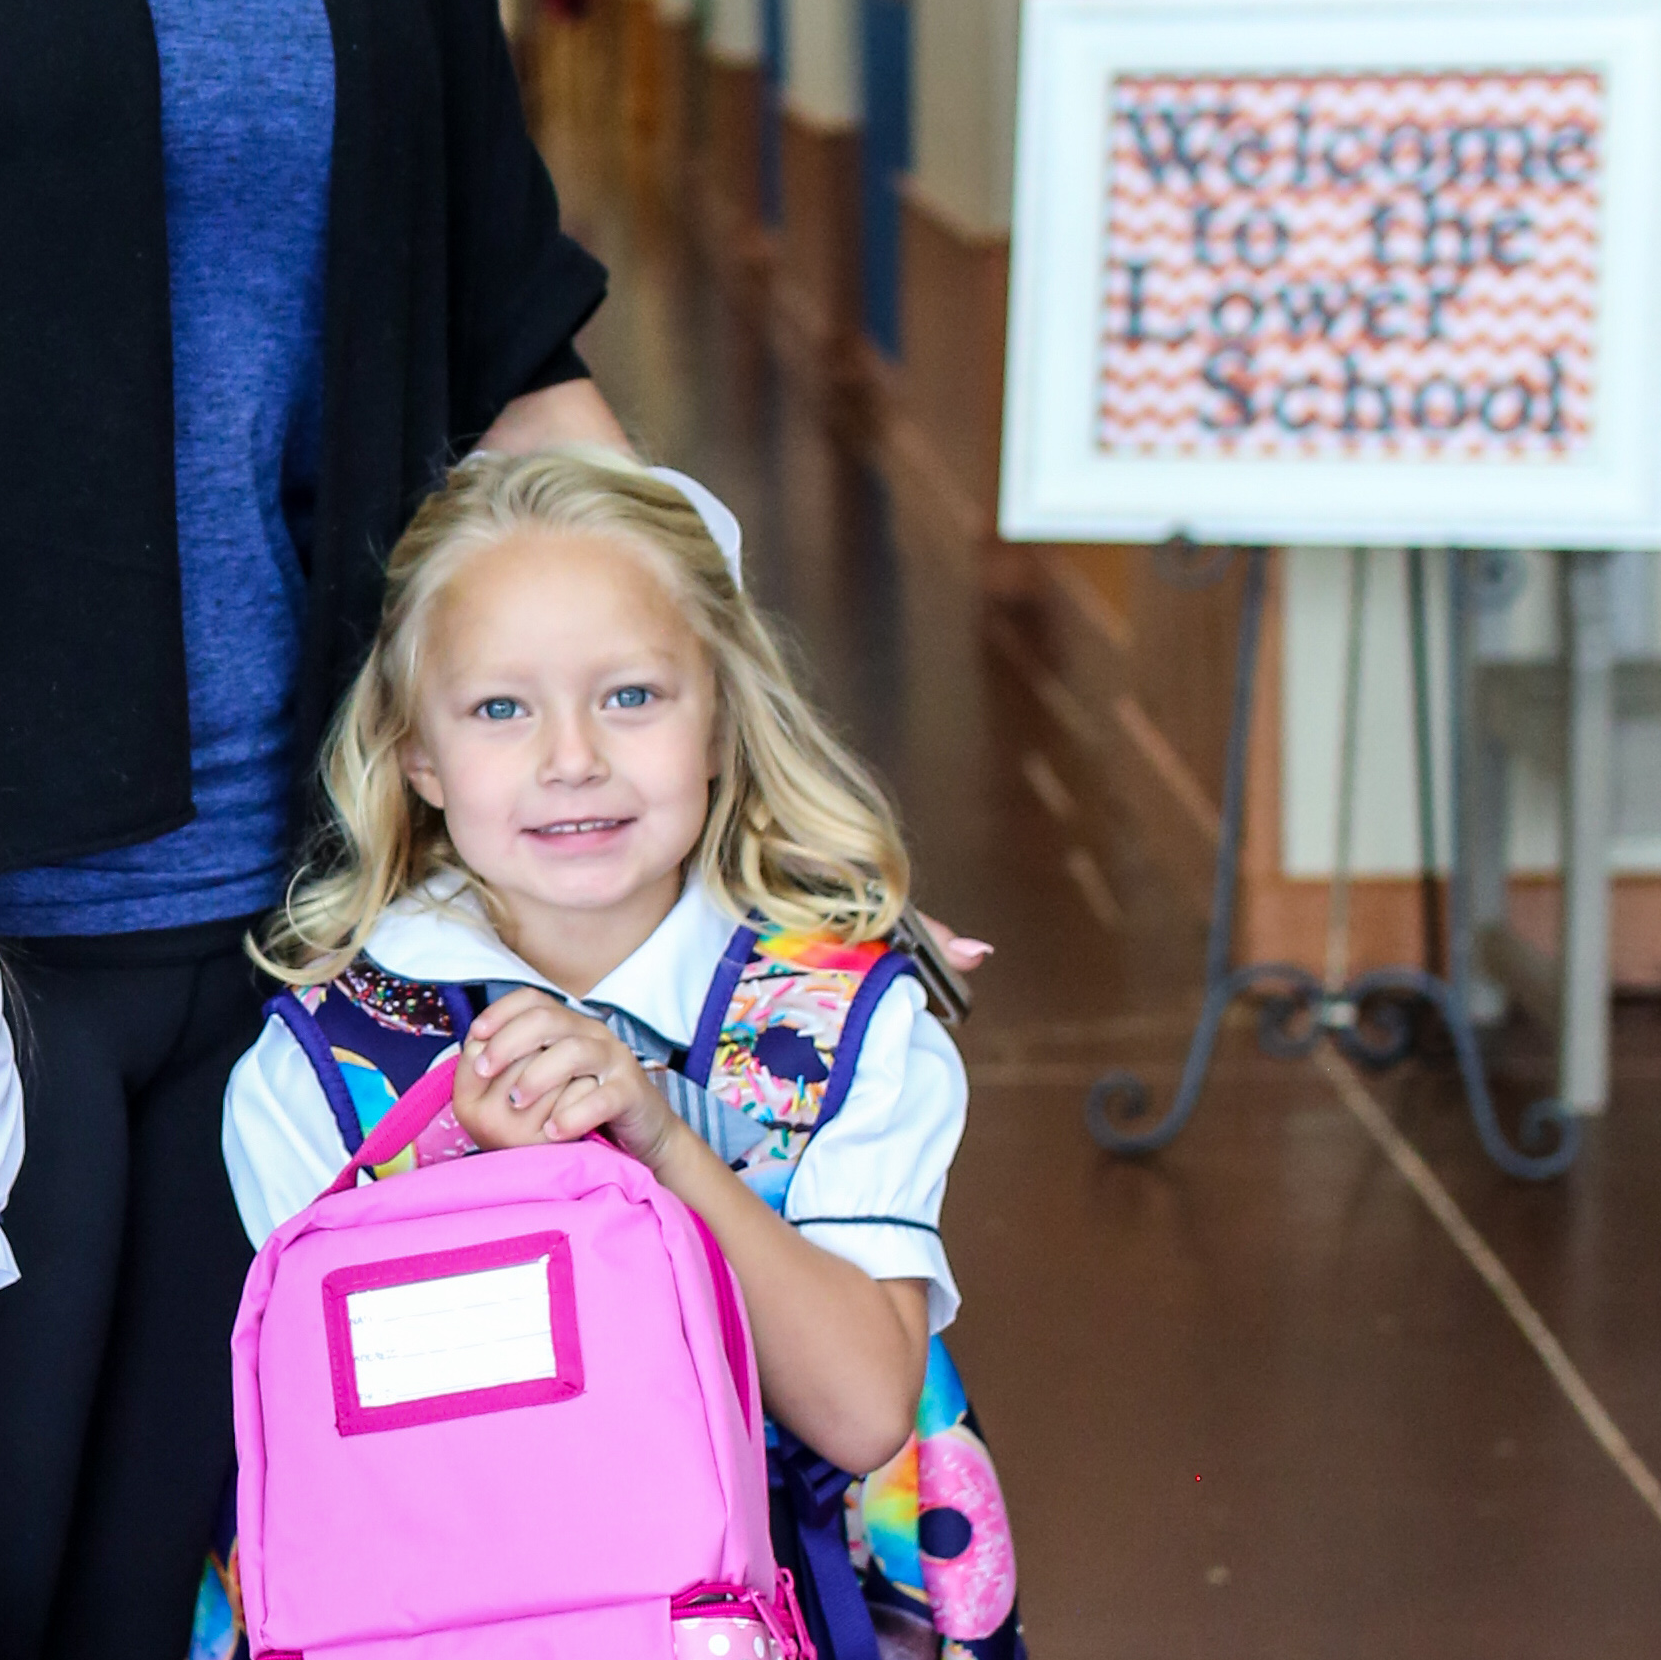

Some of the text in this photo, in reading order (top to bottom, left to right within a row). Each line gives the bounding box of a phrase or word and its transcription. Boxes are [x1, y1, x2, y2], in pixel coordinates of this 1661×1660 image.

[1118, 105, 1594, 189] Welcome
[1192, 185, 1537, 271] to the
[1118, 261, 1466, 348] Lower
[1197, 344, 1569, 437] School
